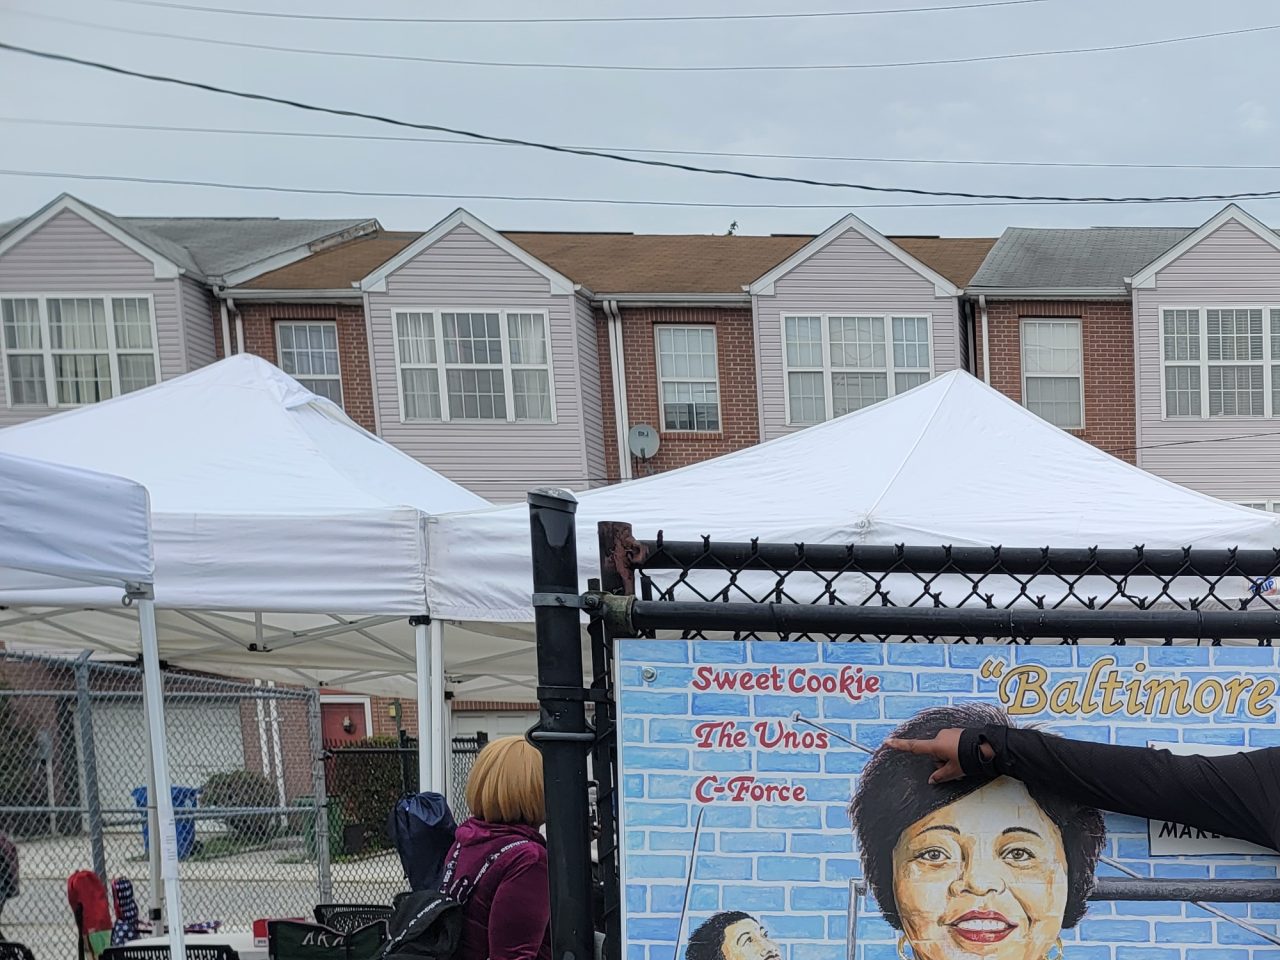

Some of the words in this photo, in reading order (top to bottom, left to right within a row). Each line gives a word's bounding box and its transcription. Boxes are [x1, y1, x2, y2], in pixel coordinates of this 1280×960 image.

[692, 665, 783, 692] Sweet
[789, 665, 880, 700] Cookie
[695, 721, 747, 749] The
[754, 720, 829, 750] Unos
[695, 775, 806, 803] C-Force
